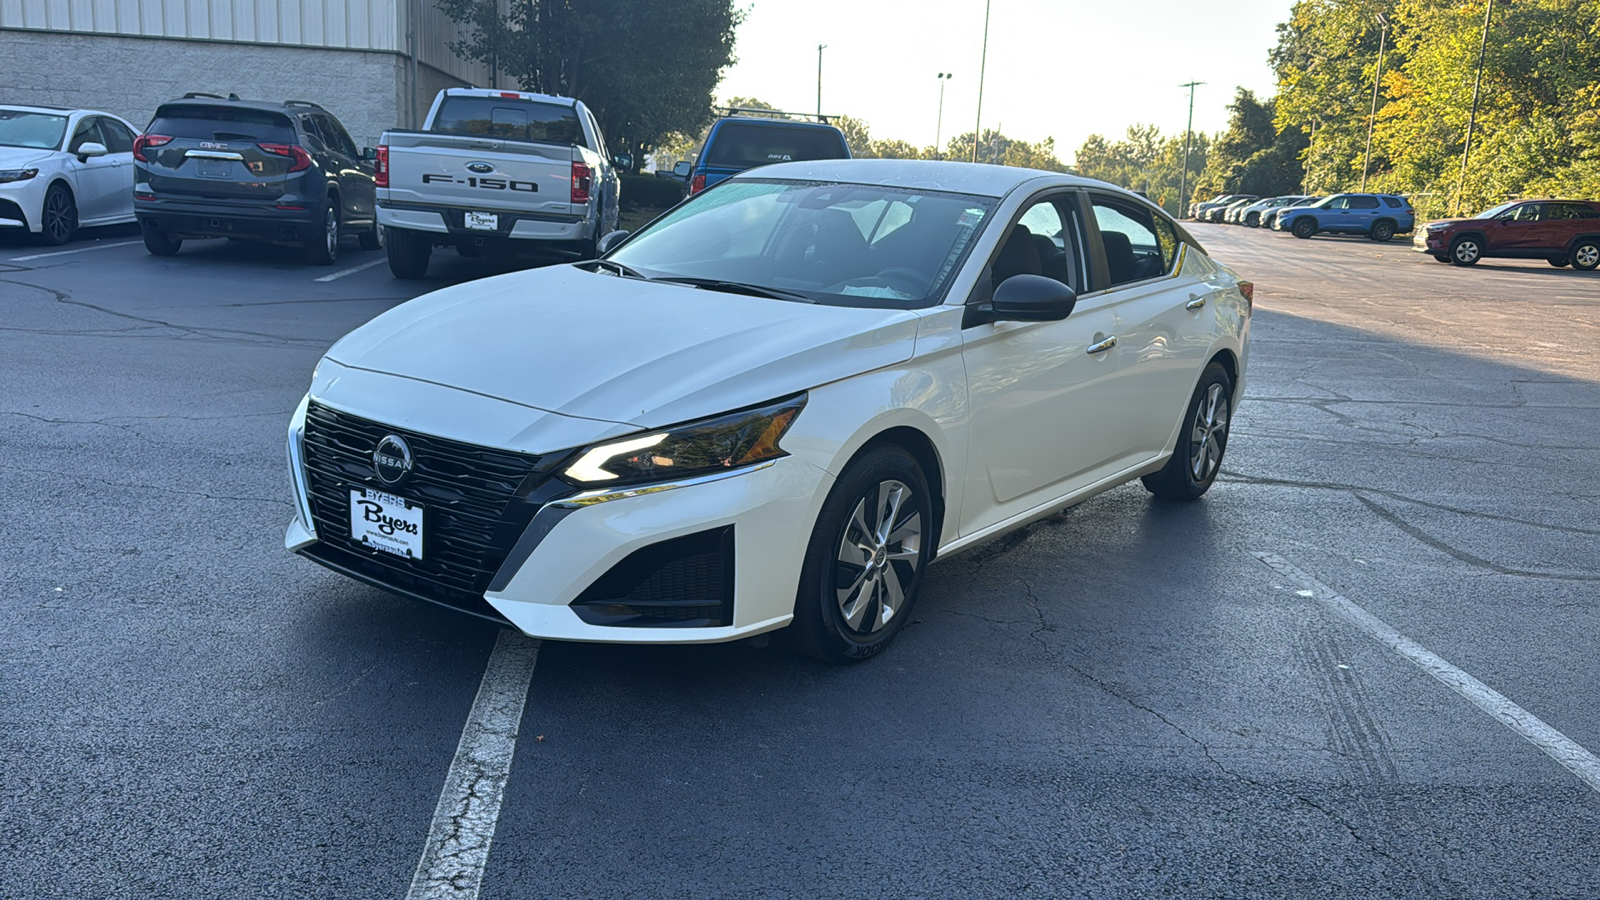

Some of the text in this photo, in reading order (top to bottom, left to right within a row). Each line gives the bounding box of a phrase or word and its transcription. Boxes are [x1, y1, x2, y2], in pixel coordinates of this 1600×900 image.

[200, 142, 228, 150] GMC
[422, 174, 538, 192] F-150
[373, 451, 412, 470] NISSAN
[366, 488, 405, 508] BYERS
[356, 500, 418, 535] Byers
